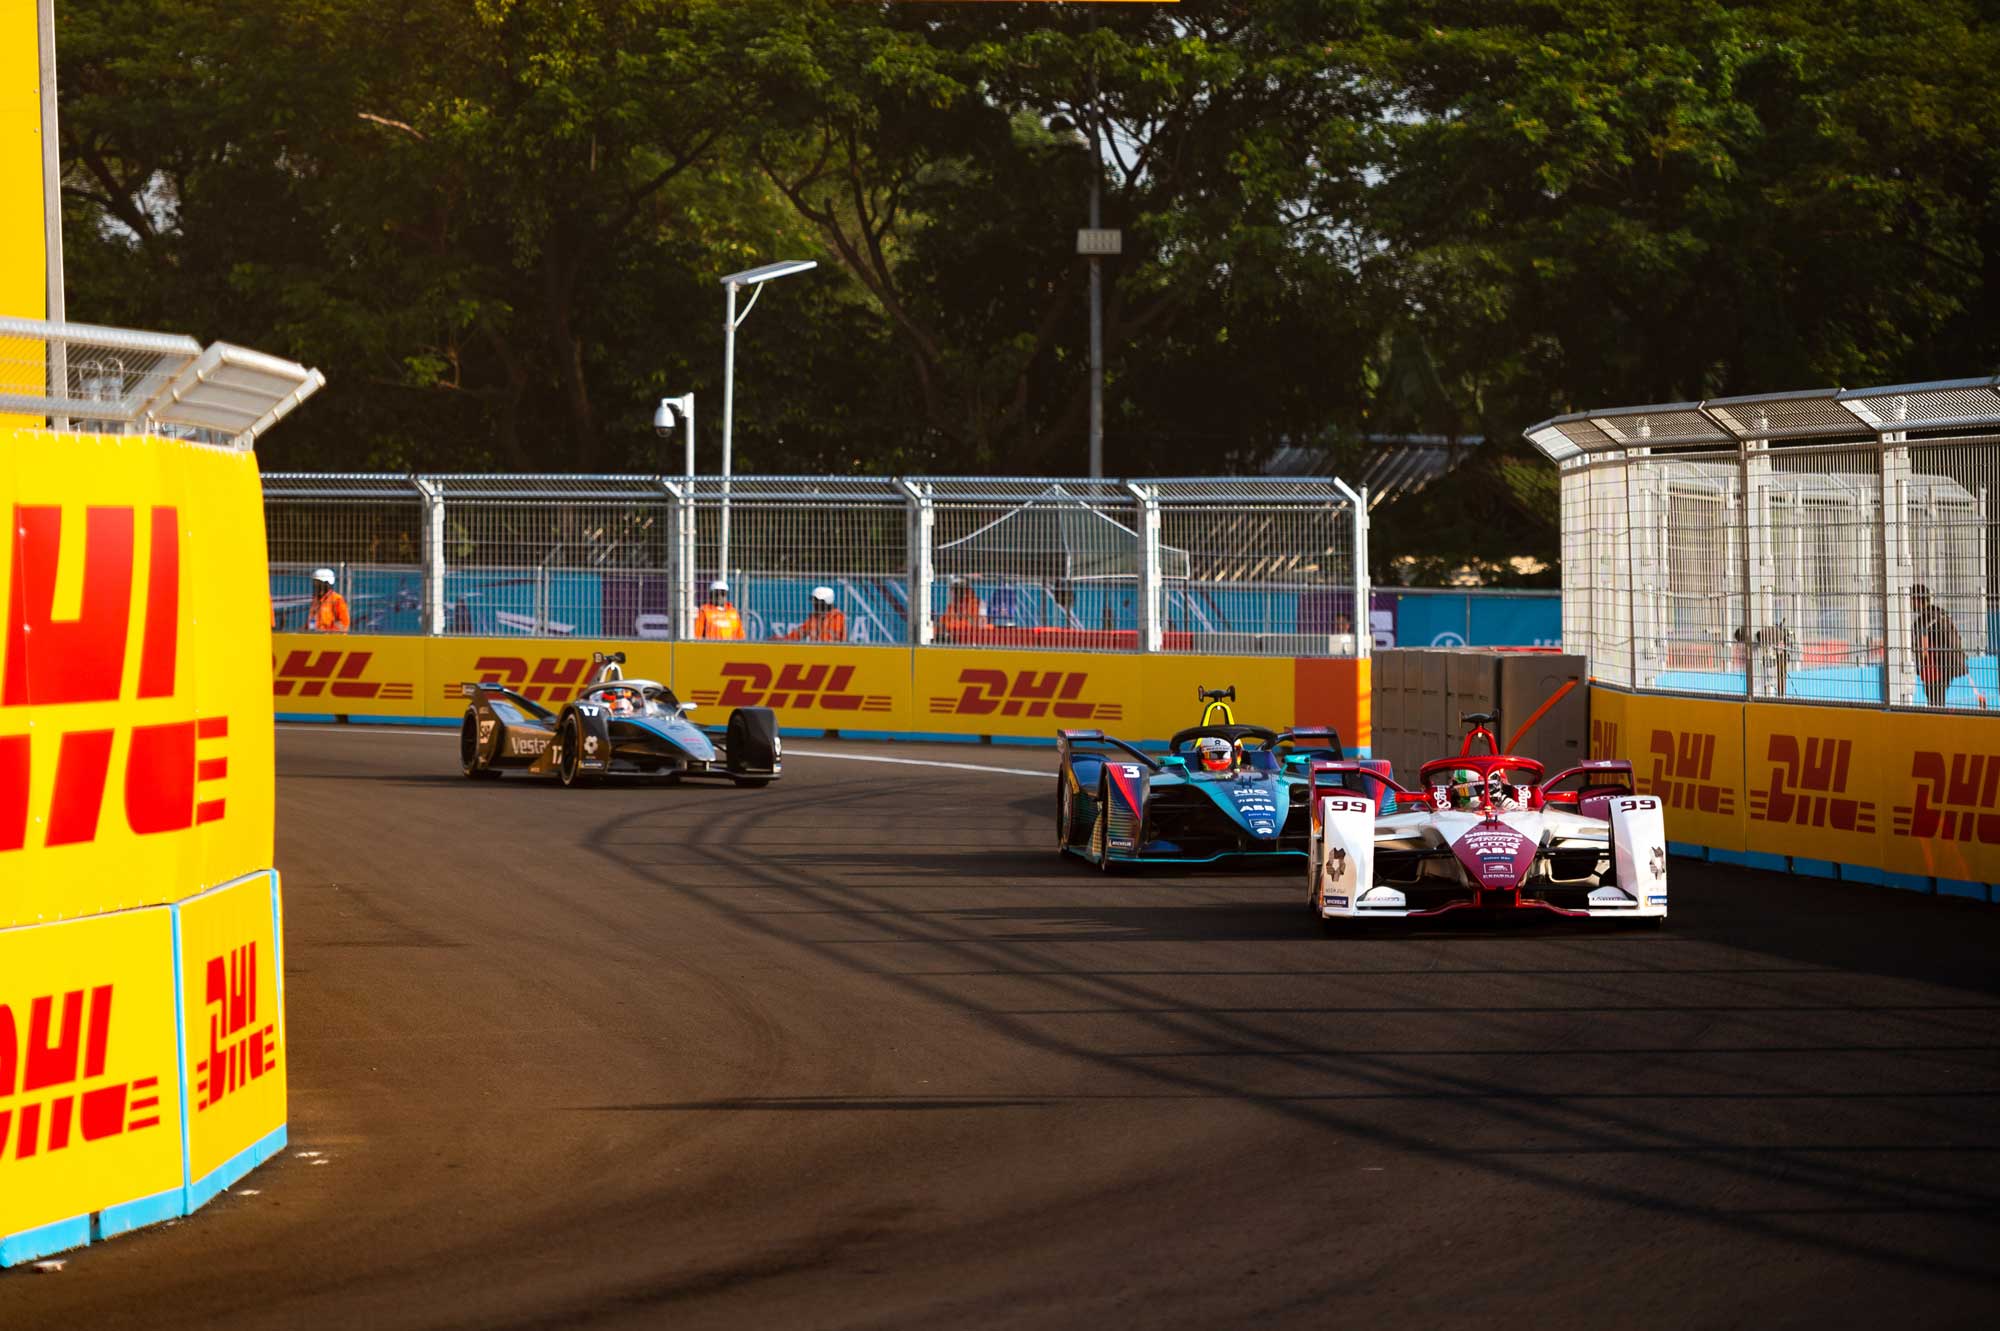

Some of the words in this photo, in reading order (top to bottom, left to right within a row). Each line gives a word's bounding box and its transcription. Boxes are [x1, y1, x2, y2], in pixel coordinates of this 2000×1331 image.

[0, 503, 198, 852] HL
[273, 650, 381, 699] HL
[718, 662, 864, 711] DHL
[955, 669, 1096, 718] DHL
[580, 705, 599, 717] 17
[511, 737, 551, 755] Vesta
[1123, 765, 1140, 778] 3
[1650, 730, 1722, 814] DHL
[1767, 734, 1859, 832] DHL
[1331, 800, 1367, 813] 99
[1620, 799, 1656, 813] 99
[1475, 847, 1519, 856] ABB
[205, 940, 265, 1107] DHL
